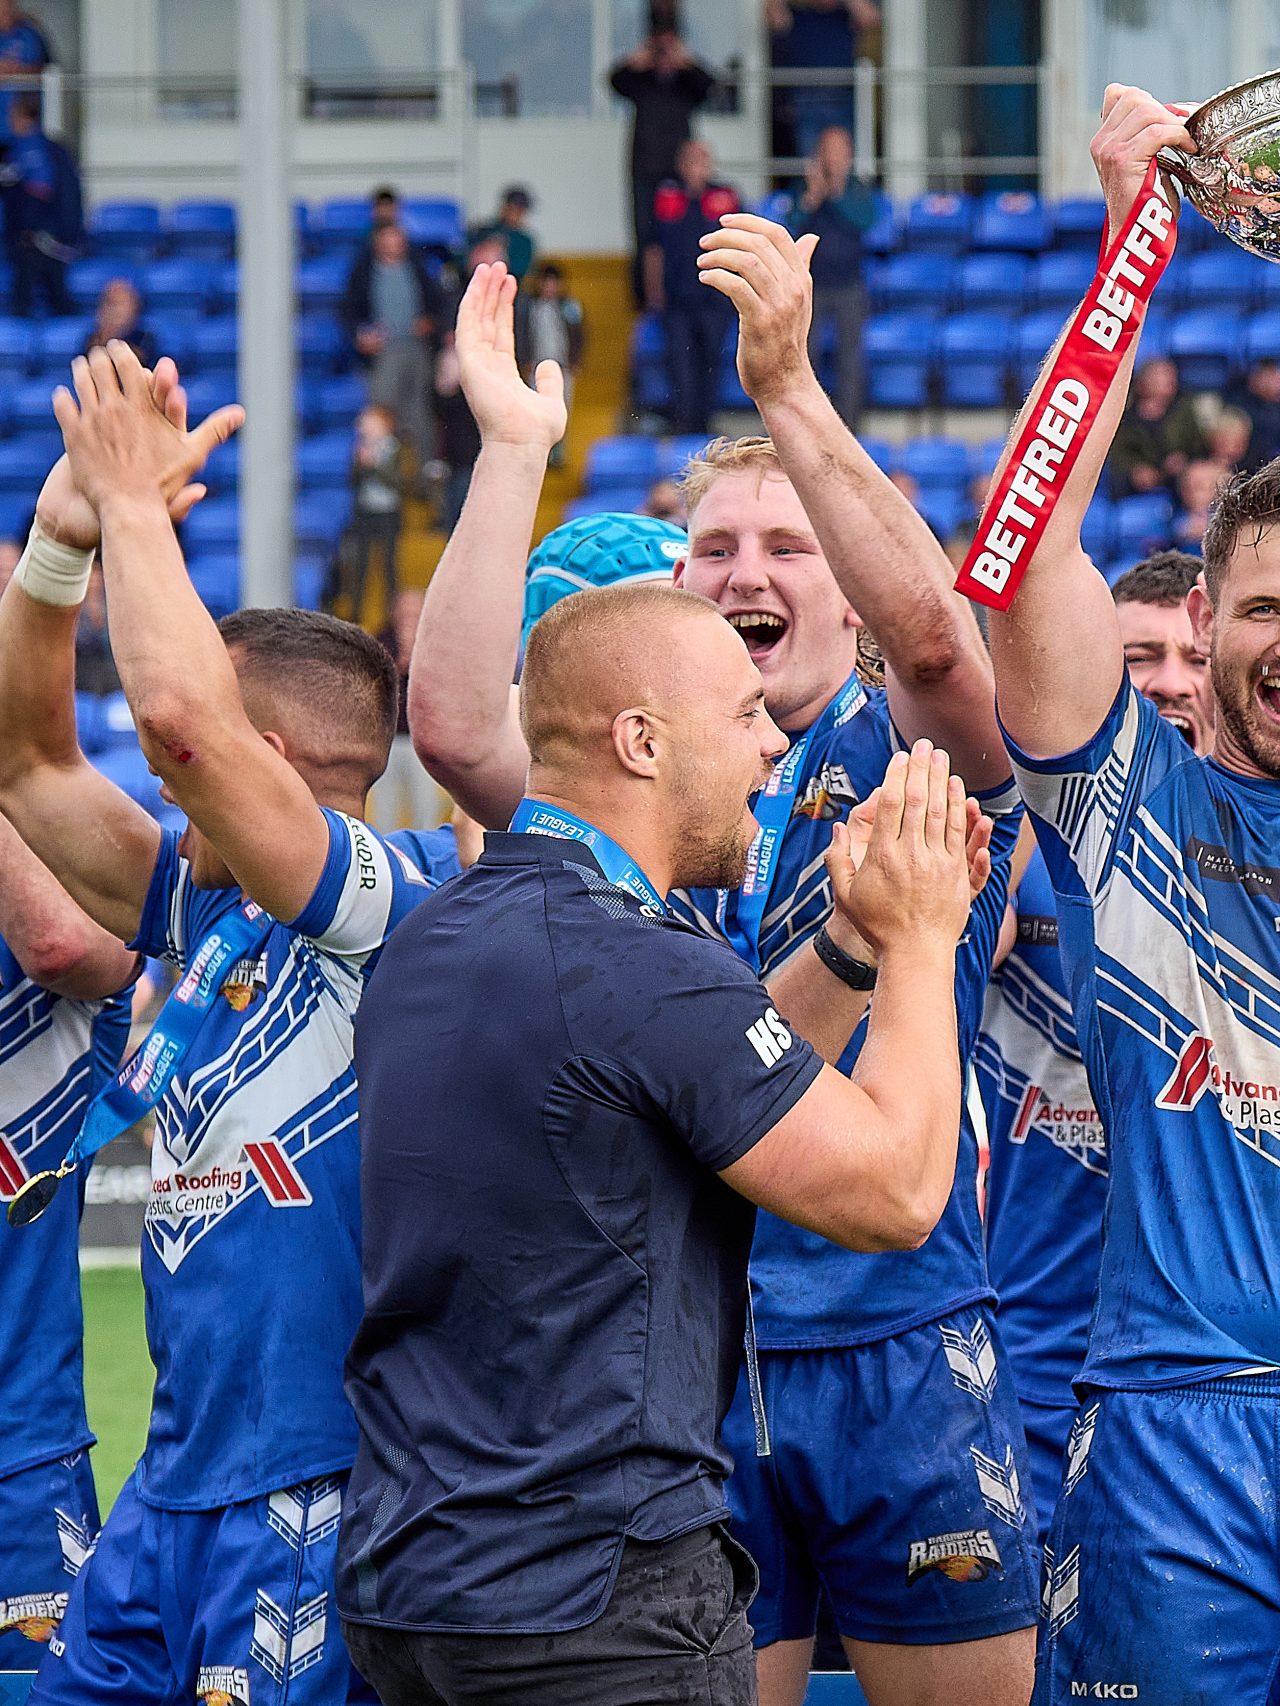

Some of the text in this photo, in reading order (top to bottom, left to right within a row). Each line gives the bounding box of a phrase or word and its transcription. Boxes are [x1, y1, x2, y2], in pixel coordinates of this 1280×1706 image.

[970, 378, 1090, 594] BETFRED
[536, 812, 585, 838] LEAGUE
[347, 816, 376, 890] NDER
[757, 837, 776, 882] LEAGUE
[176, 934, 223, 1004] BETFRED
[198, 948, 227, 997] LEAGUE
[149, 1047, 175, 1093] LEAGUE
[175, 1168, 242, 1192] Roofing
[175, 1193, 223, 1212] Centre
[908, 1529, 1002, 1576] RAIDERS
[197, 1668, 250, 1706] AIDERS
